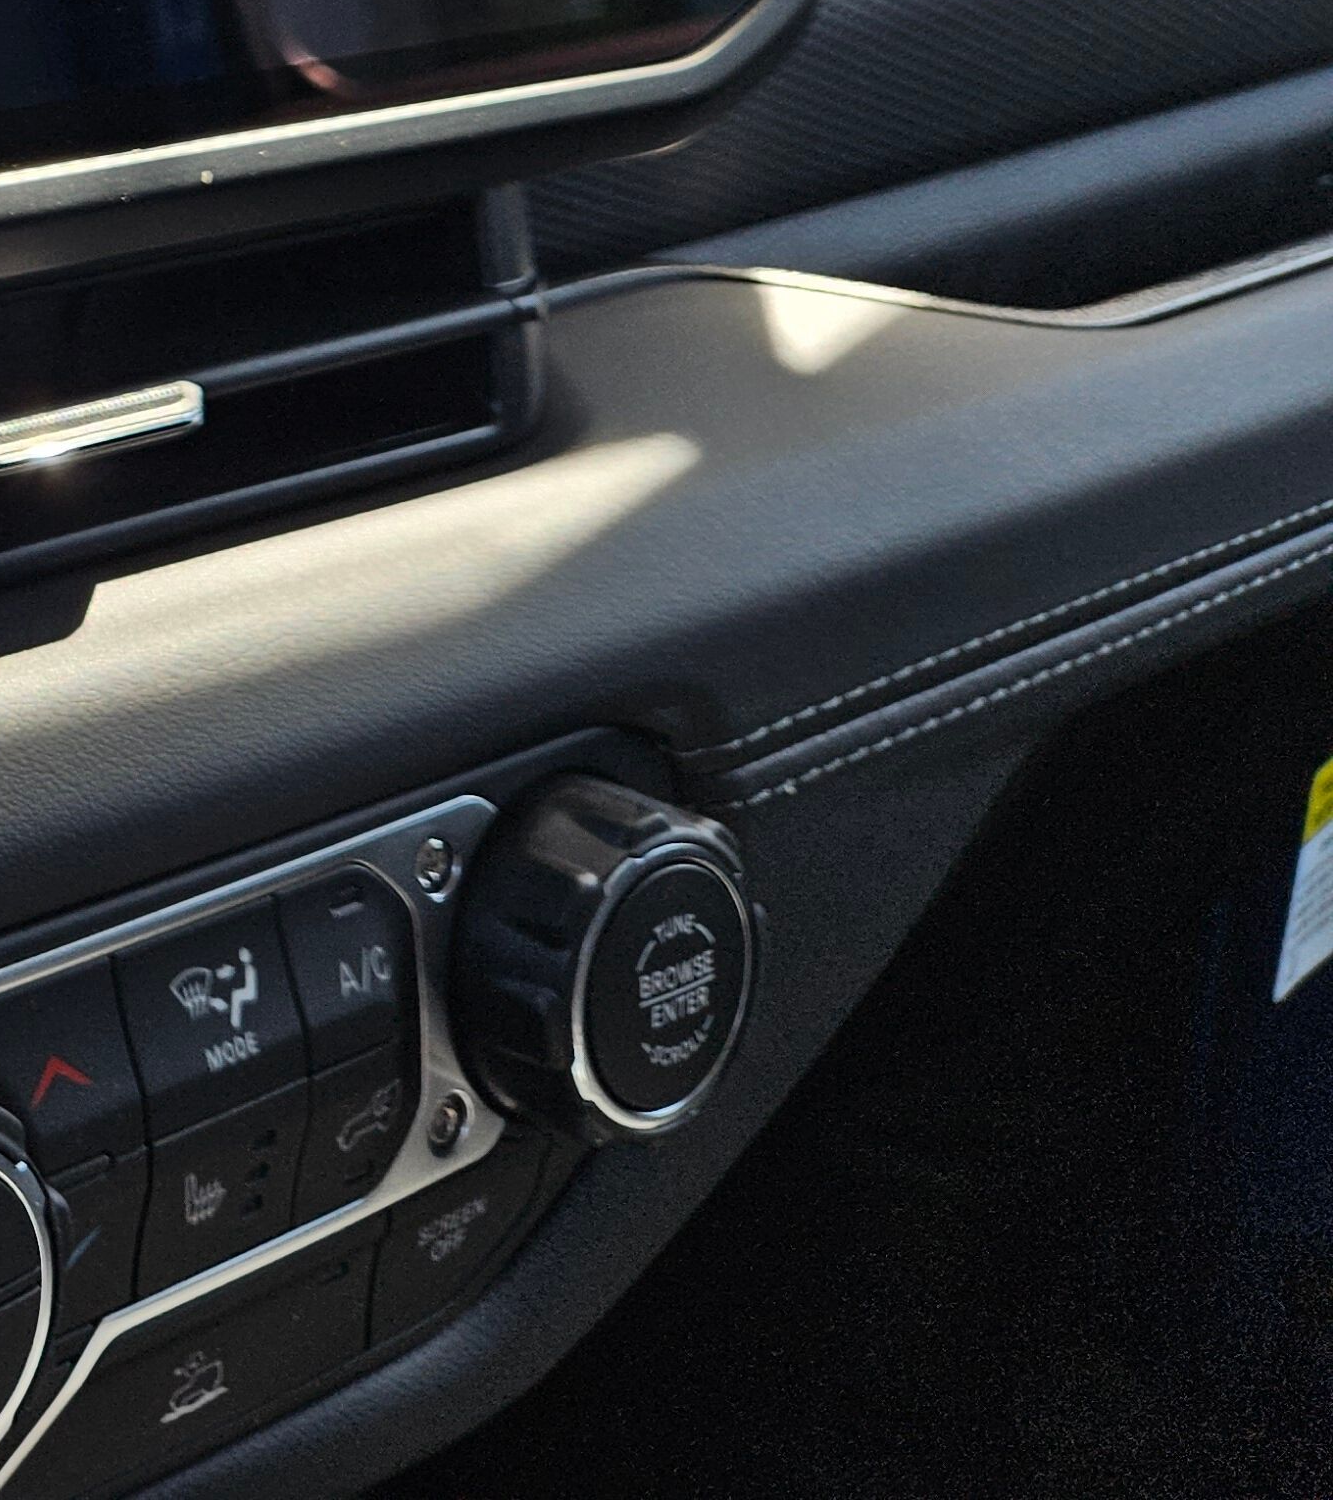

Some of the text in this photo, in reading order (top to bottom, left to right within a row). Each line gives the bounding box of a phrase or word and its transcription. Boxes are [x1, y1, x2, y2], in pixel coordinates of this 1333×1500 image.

[652, 913, 696, 943] TUNE
[338, 945, 393, 998] A/C
[638, 950, 716, 999] BROWSE
[650, 986, 710, 1029] ENTER
[204, 1031, 261, 1073] MODE
